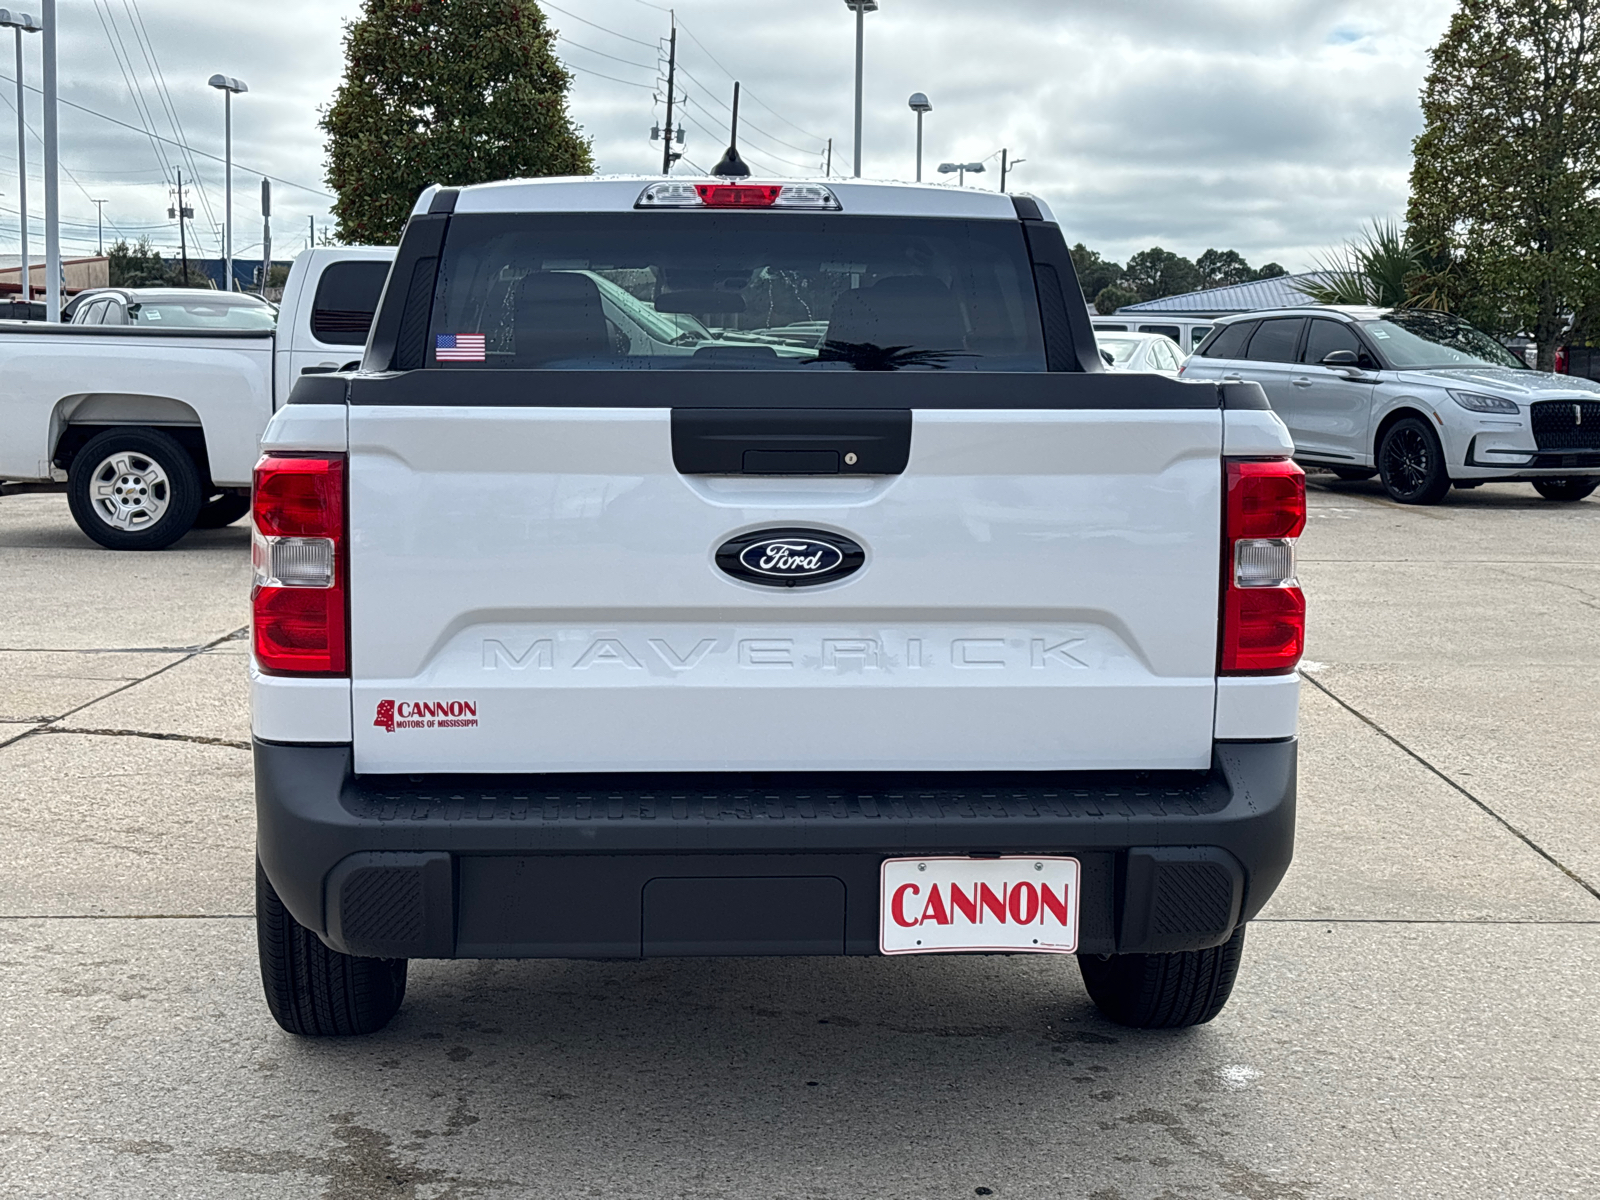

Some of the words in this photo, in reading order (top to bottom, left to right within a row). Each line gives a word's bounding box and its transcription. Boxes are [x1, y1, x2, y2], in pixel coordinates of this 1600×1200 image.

[759, 544, 823, 569] Ford
[482, 638, 1090, 670] MAVERICK
[397, 701, 476, 718] CANNON
[396, 720, 425, 728] MOTORS
[427, 720, 436, 728] OF
[437, 719, 478, 728] MISSISSIPPI
[891, 881, 1069, 928] CANNON
